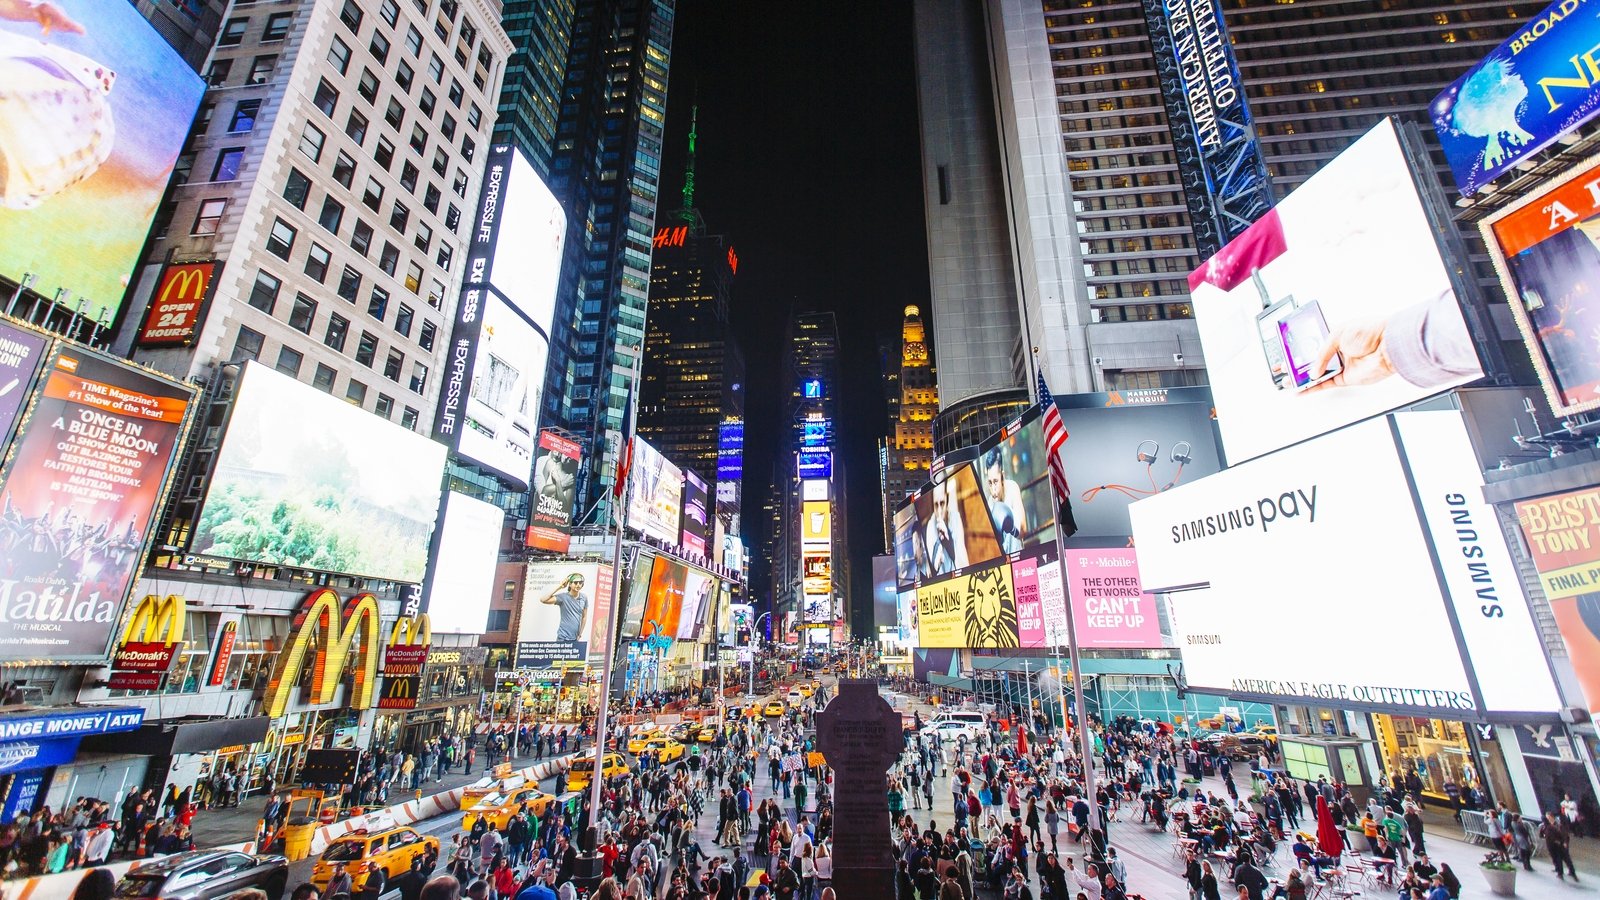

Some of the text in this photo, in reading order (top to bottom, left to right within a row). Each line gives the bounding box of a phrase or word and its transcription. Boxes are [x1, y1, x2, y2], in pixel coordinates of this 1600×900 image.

[1179, 33, 1221, 147] AMERICAN
[478, 165, 503, 243] #EXPRESSLIFE
[653, 226, 688, 248] H&M
[159, 303, 196, 313] OPEN
[157, 312, 187, 327] 24
[145, 328, 190, 338] HOURS
[0, 337, 30, 358] NING
[81, 381, 159, 408] TIME Magazine's
[441, 339, 470, 435] #EXPRESSLIFE
[1127, 389, 1168, 397] MARRIOTT
[68, 390, 164, 419] #1 Show of the Year!
[1128, 396, 1167, 404] MARQUIS
[51, 417, 159, 456] A BLUE MOON,
[125, 422, 143, 437] IN
[57, 442, 142, 469] OUT BLAZING AND
[66, 434, 139, 459] A SHOW COMES
[43, 459, 142, 488] FAITH IN BROADWAY.
[60, 453, 134, 476] RESTORES YOUR
[50, 481, 62, 491] IS
[62, 482, 89, 497] THAT
[68, 475, 113, 492] MATILDA
[1171, 485, 1317, 543] SAMSUNG pay
[1521, 492, 1600, 533] BEST
[1532, 527, 1591, 554] TONY
[1445, 493, 1504, 618] SAMSUNG
[24, 575, 45, 584] Roald
[1082, 577, 1138, 587] THE OTHER
[1547, 573, 1589, 592] FINAL
[1017, 584, 1037, 595] THE OTHER
[1017, 593, 1039, 604] NETWORKS
[1084, 588, 1140, 597] NETWORKS
[920, 587, 961, 615] THE LION KING
[1085, 597, 1141, 615] CAN'T
[13, 623, 63, 631] THE MUSICAL
[1087, 615, 1145, 628] KEEP UP
[116, 651, 169, 661] McDonald's
[428, 652, 461, 663] EXPRESS
[1231, 678, 1475, 709] AMERICAN EAGLE OUTFITTERS
[47, 716, 105, 733] MONEY
[110, 713, 141, 728] ATM
